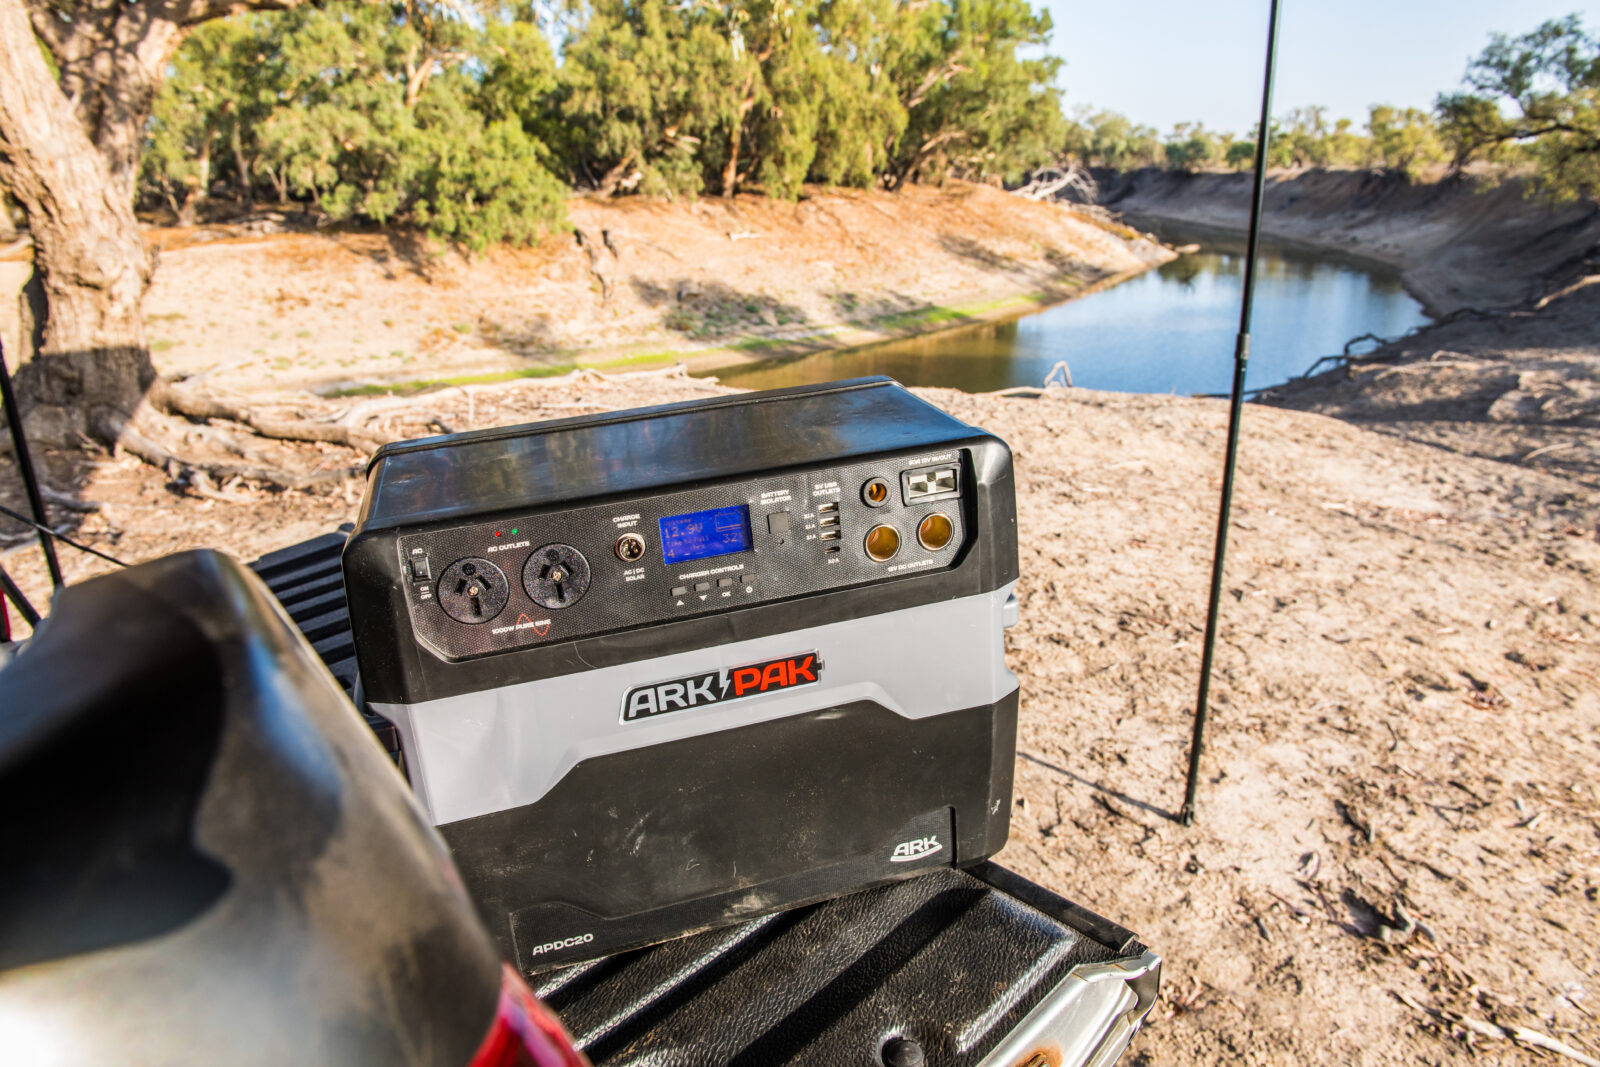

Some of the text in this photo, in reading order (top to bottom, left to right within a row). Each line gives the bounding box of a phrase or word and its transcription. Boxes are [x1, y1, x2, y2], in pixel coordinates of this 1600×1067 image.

[760, 489, 790, 499] BATTERY
[812, 487, 841, 497] OUTLETS
[760, 495, 792, 505] ISOLATOR
[613, 514, 641, 522] CHARGE
[499, 541, 530, 550] OUTLETS
[907, 559, 934, 569] OUTLETS
[679, 564, 745, 579] CHARGER CONTROLS
[625, 573, 645, 582] SOLAR
[721, 590, 732, 598] OK
[515, 621, 535, 631] PURE
[534, 618, 552, 627] SINE
[628, 655, 816, 718] ARK PAK
[893, 835, 941, 856] ARK
[532, 933, 595, 957] APDC20
